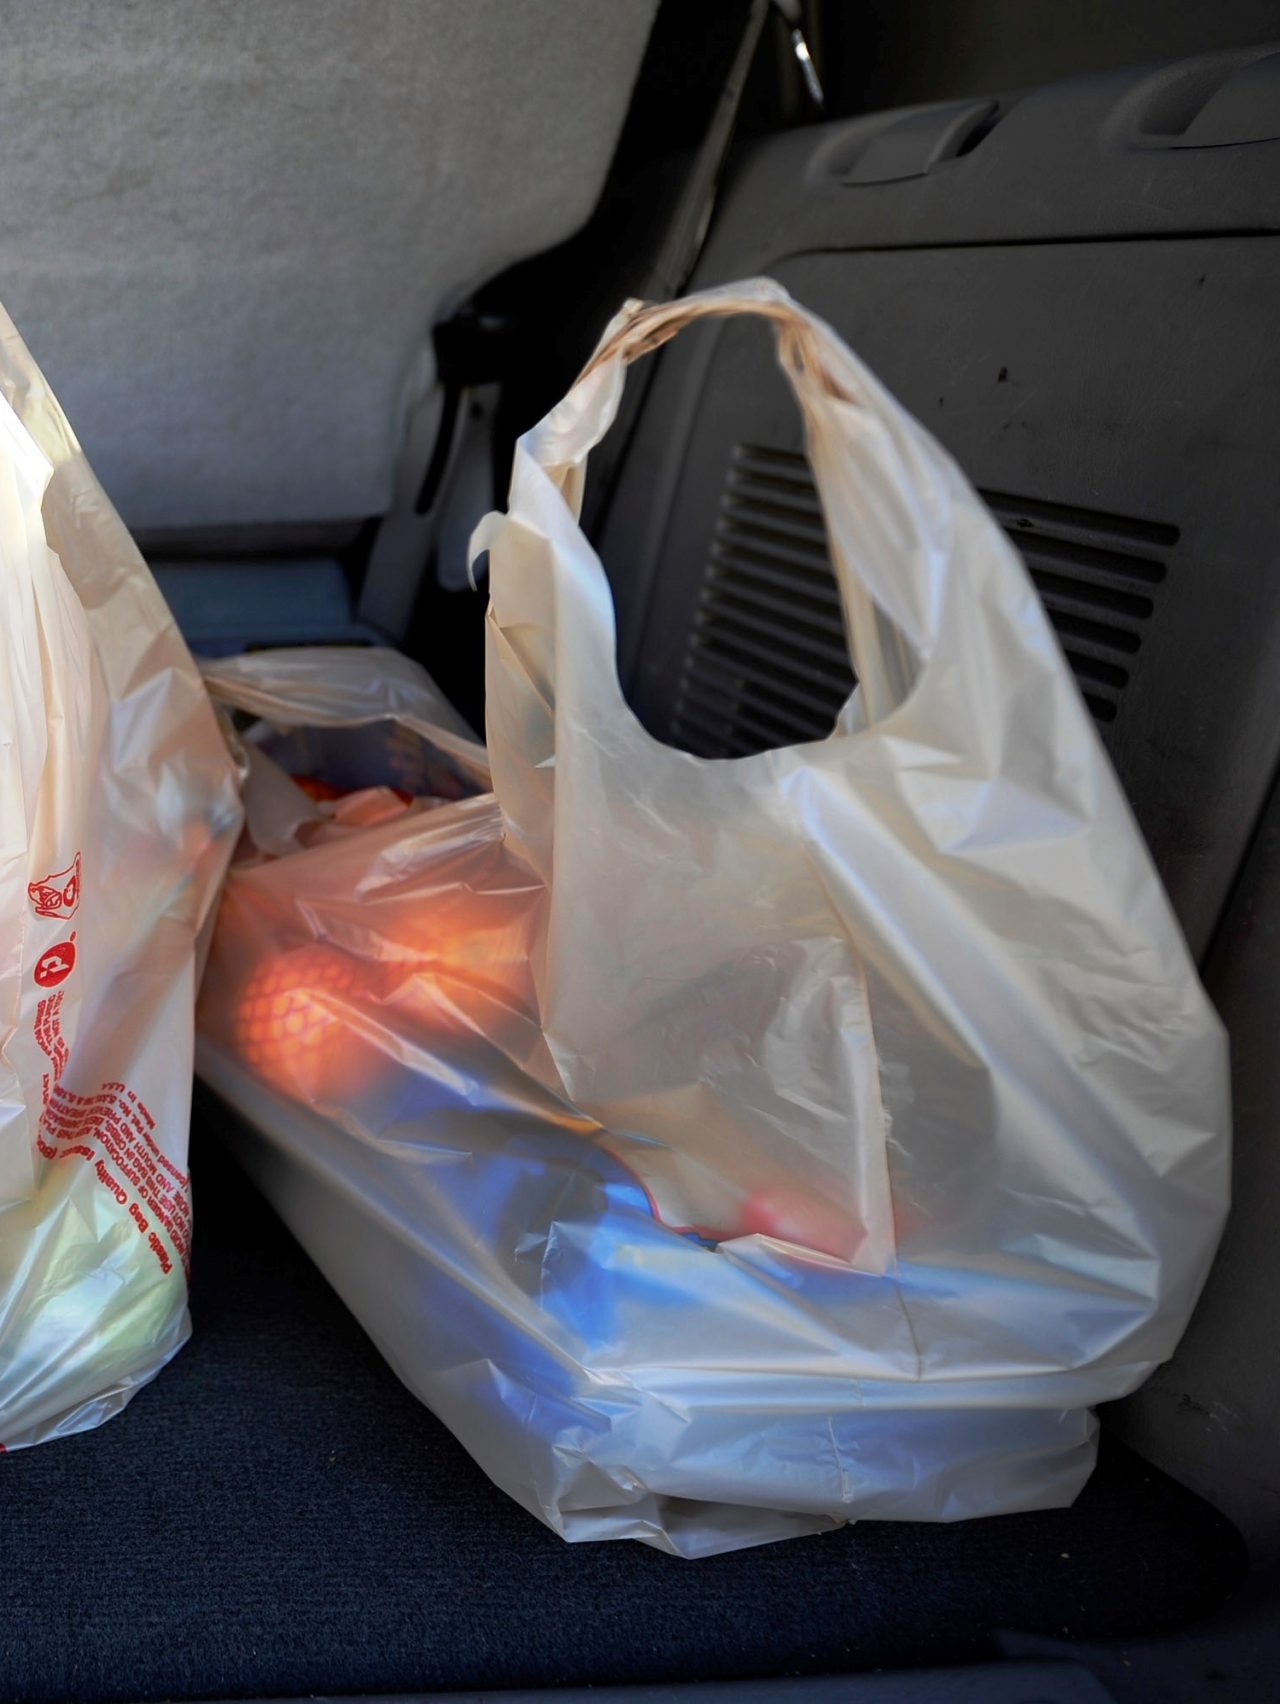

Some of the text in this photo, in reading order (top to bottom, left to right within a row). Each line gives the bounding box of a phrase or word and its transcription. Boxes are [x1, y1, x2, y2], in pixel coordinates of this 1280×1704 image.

[126, 1091, 137, 1102] in
[118, 1100, 132, 1117] No.
[137, 1102, 156, 1130] Made
[120, 1123, 136, 1142] AND
[131, 1114, 144, 1134] Pat.
[124, 1147, 135, 1160] IN
[143, 1132, 160, 1157] under
[132, 1157, 148, 1179] BAG
[134, 1142, 157, 1175] MOUTH
[95, 1160, 127, 1204] Quality
[138, 1185, 148, 1198] OF
[146, 1176, 161, 1198] THIS
[156, 1174, 175, 1193] AND
[147, 1196, 174, 1232] DANGER
[159, 1195, 176, 1215] USE
[173, 1191, 189, 1217] NOSE
[128, 1203, 148, 1233] Bag
[148, 1232, 173, 1274] Plastic
